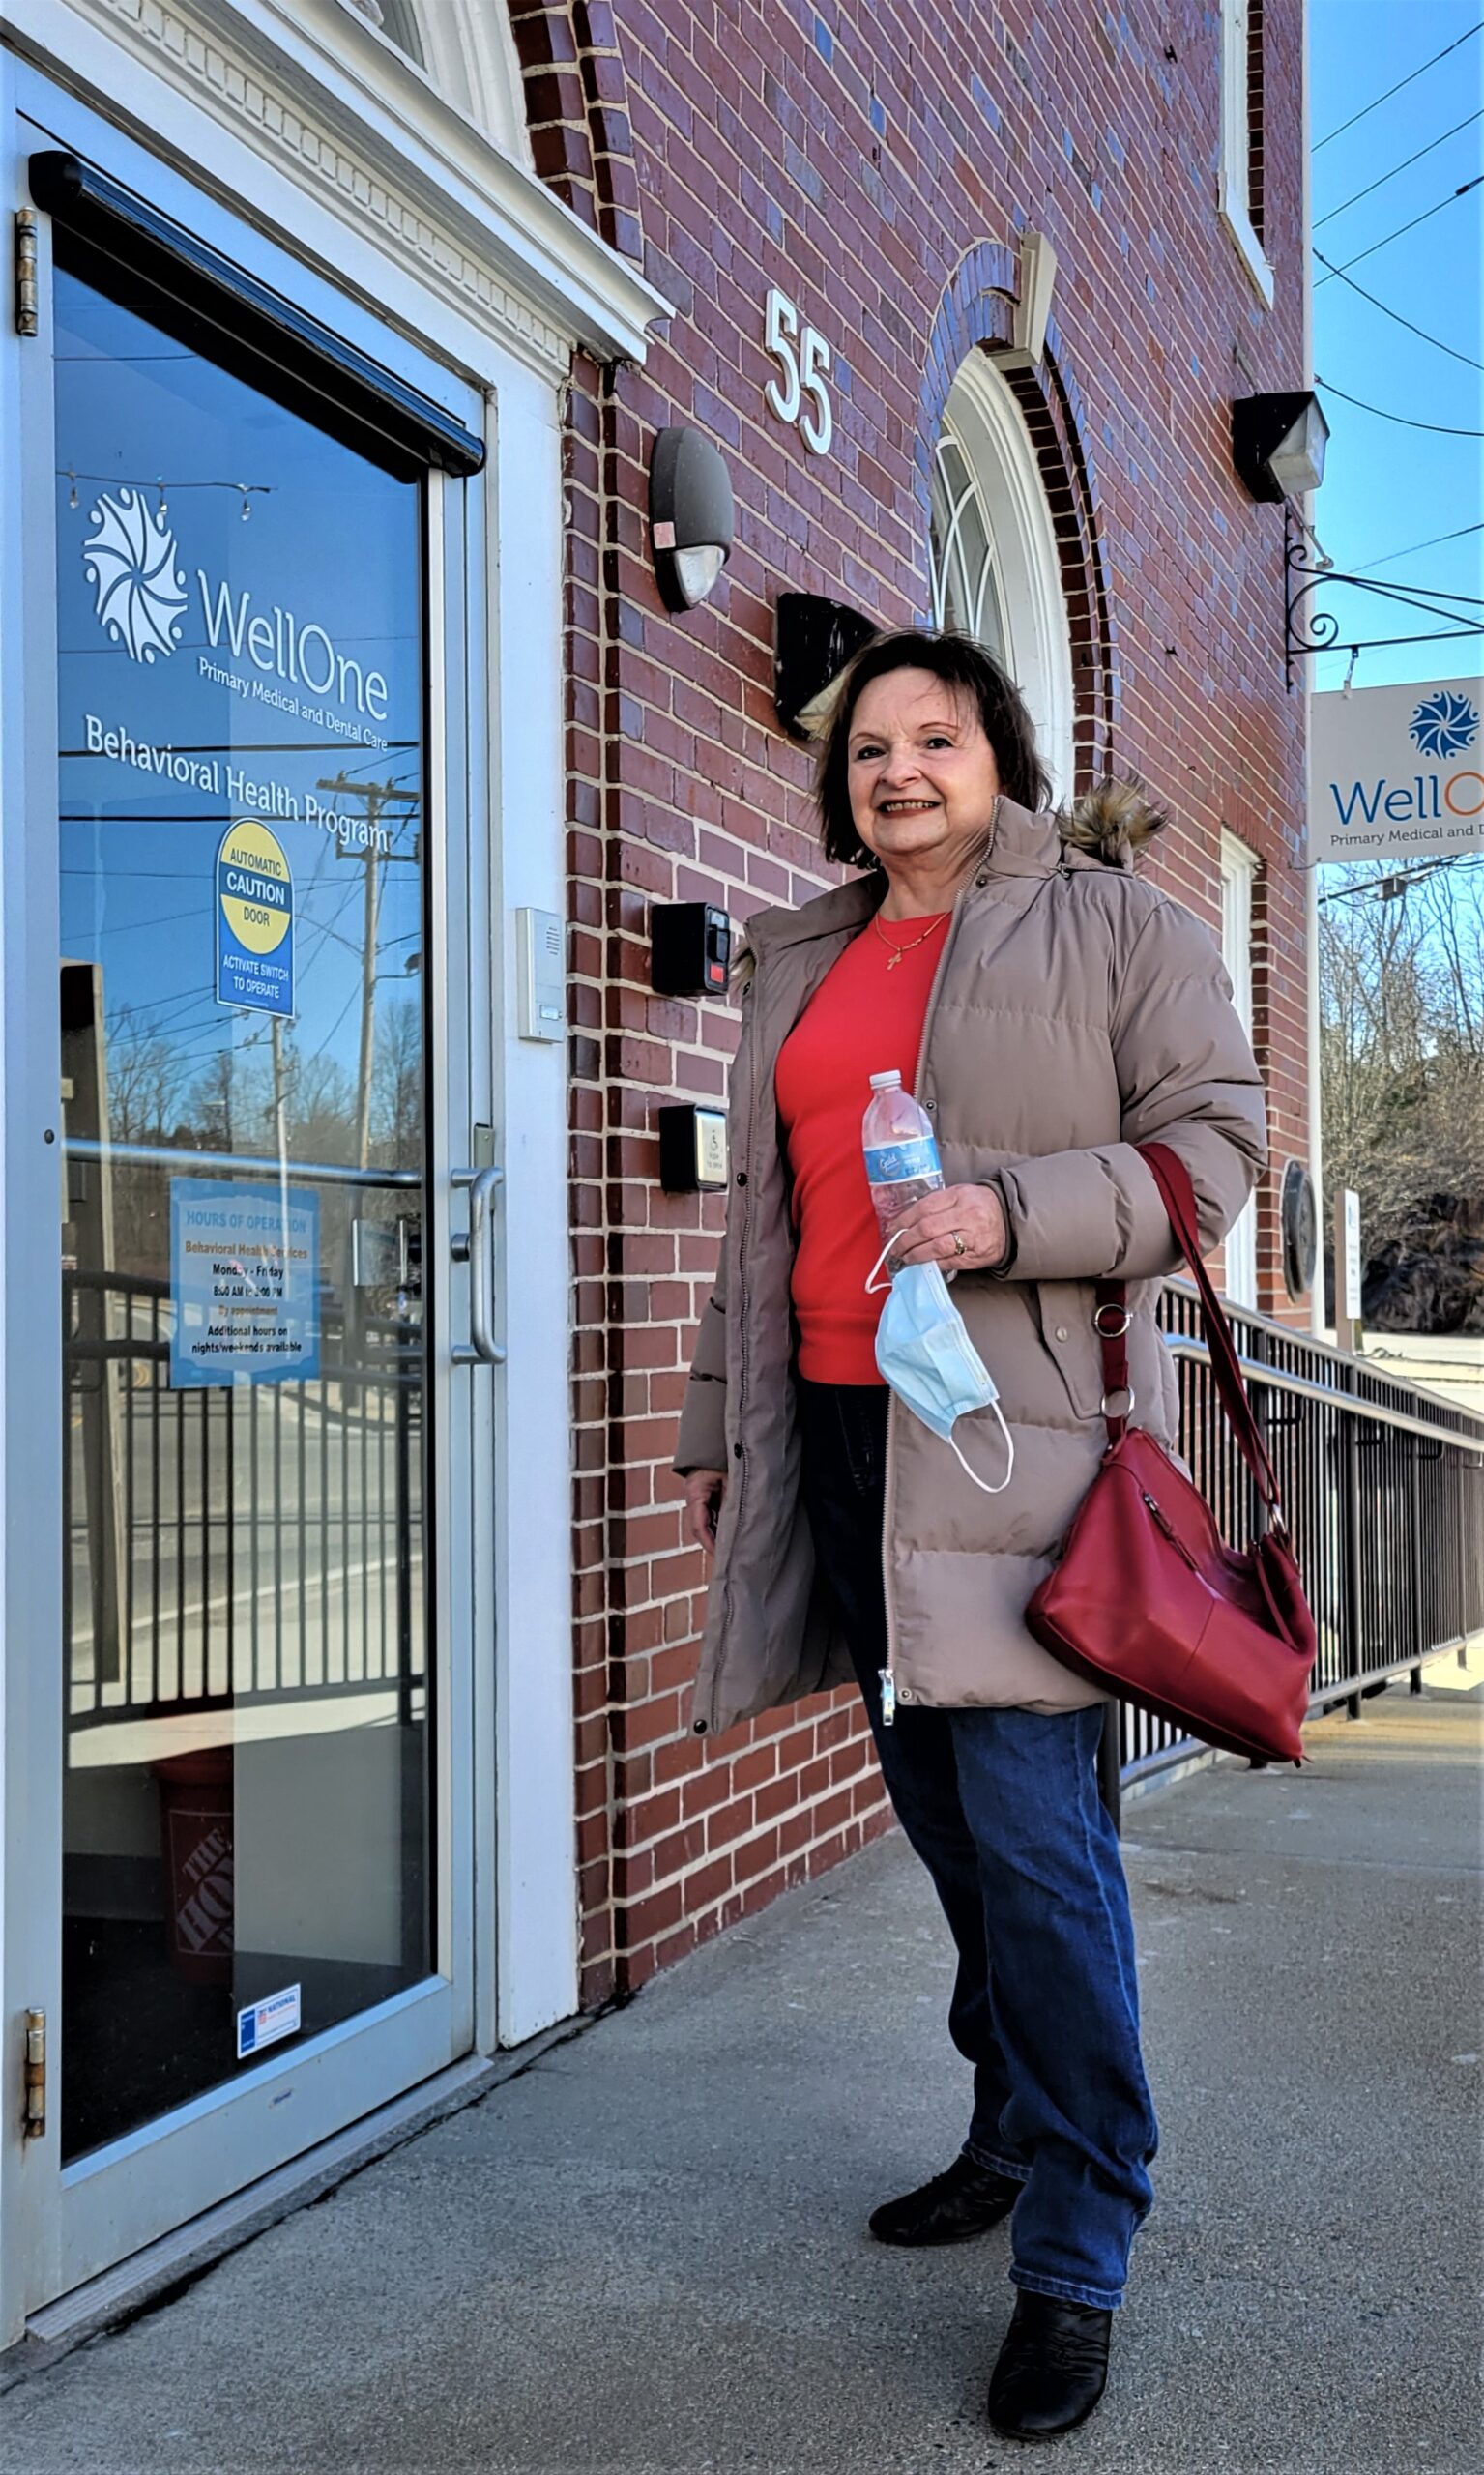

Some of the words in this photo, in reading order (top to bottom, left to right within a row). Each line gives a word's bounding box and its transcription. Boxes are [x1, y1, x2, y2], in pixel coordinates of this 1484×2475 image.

[765, 288, 832, 455] 55
[196, 568, 388, 721] WellOne
[199, 656, 249, 698] Primary
[252, 681, 299, 715] Medical
[302, 705, 324, 725] and
[326, 711, 362, 742] Dental
[363, 728, 388, 752] Care
[85, 713, 219, 795] Behavioral
[226, 765, 299, 822] Health
[305, 793, 388, 853] Program
[1330, 833, 1385, 847] Primary
[1388, 827, 1443, 842] Medical
[1447, 823, 1474, 838] and
[230, 847, 282, 877] AUTOMATIC
[226, 871, 285, 906] CAUTION
[243, 906, 270, 927] DOOR
[223, 953, 258, 975] ACTIVATE
[260, 963, 289, 982] SWITCH
[233, 975, 245, 991] TO
[246, 978, 279, 999] OPERATE
[187, 1210, 226, 1228] HOURS
[229, 1214, 245, 1229] OF
[247, 1215, 306, 1233] OPERAON
[185, 1240, 236, 1256] Behavioral
[239, 1243, 269, 1257] Health
[213, 1263, 247, 1279] Mondy
[232, 1286, 244, 1297] AM
[208, 1325, 250, 1336] Additional
[253, 1325, 276, 1336] hours
[277, 1327, 288, 1336] on
